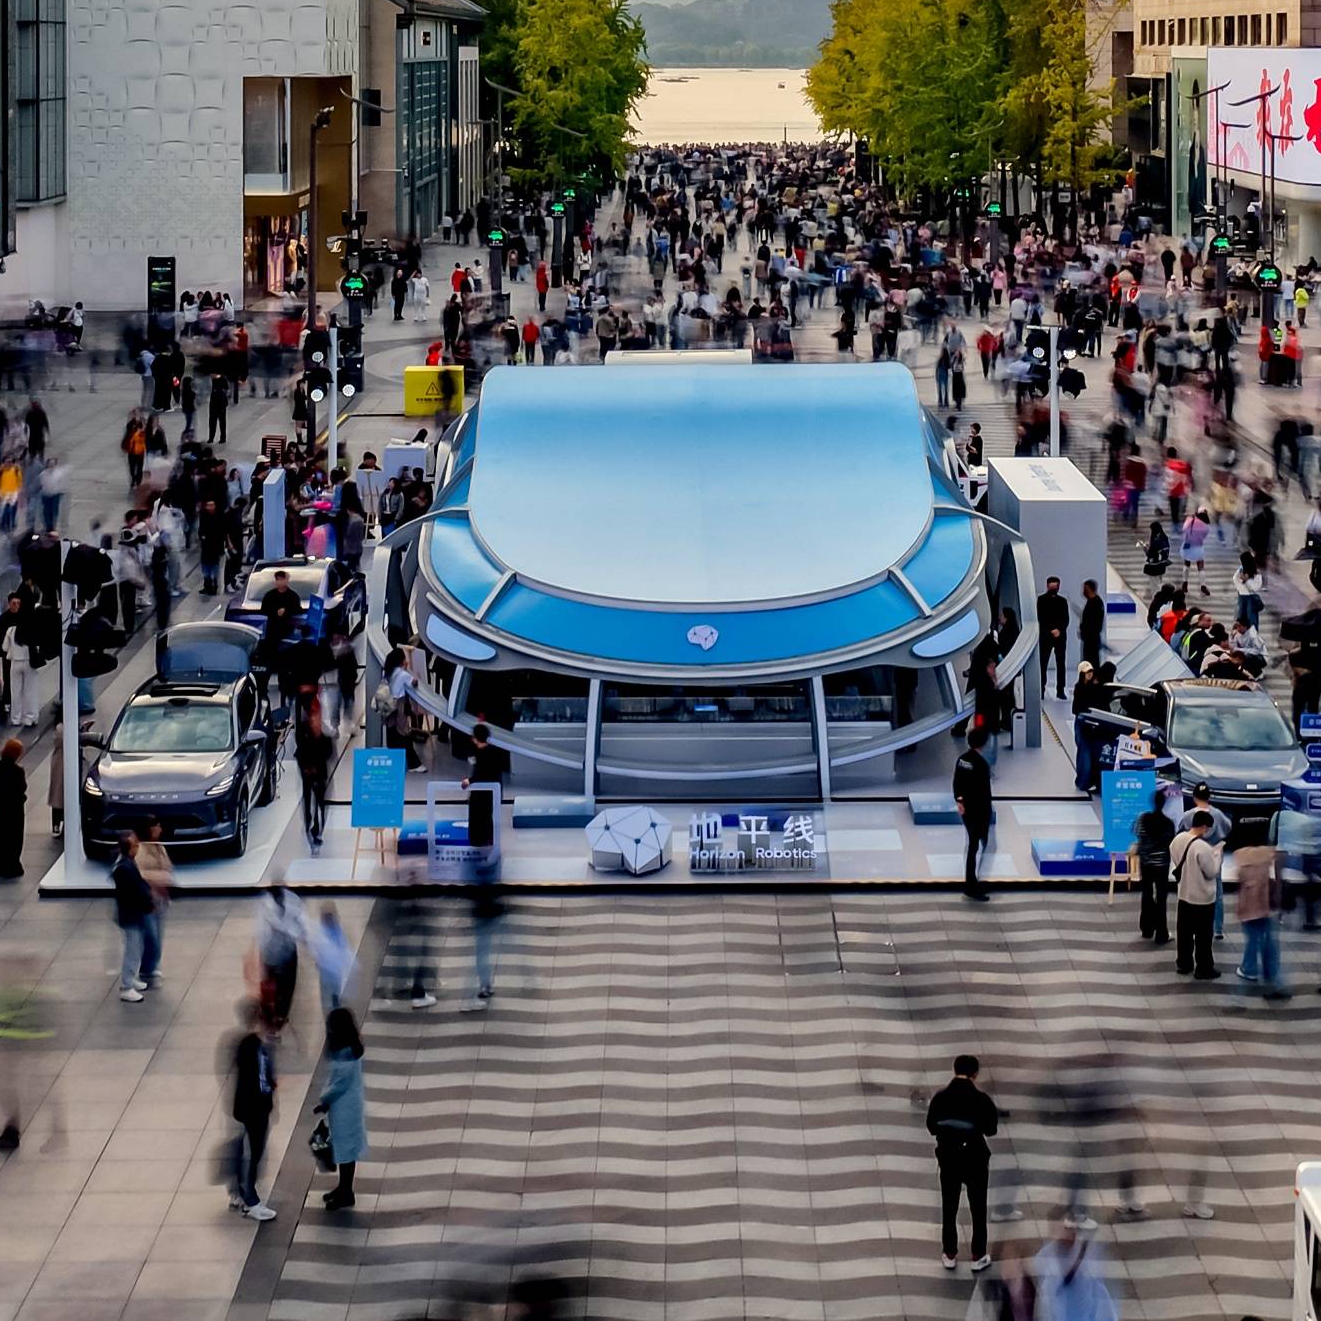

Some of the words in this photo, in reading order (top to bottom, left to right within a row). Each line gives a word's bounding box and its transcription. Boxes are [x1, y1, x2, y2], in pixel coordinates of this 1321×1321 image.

[689, 811, 815, 845] 地平线
[689, 845, 746, 860] Horizon
[755, 846, 818, 860] Robotics
